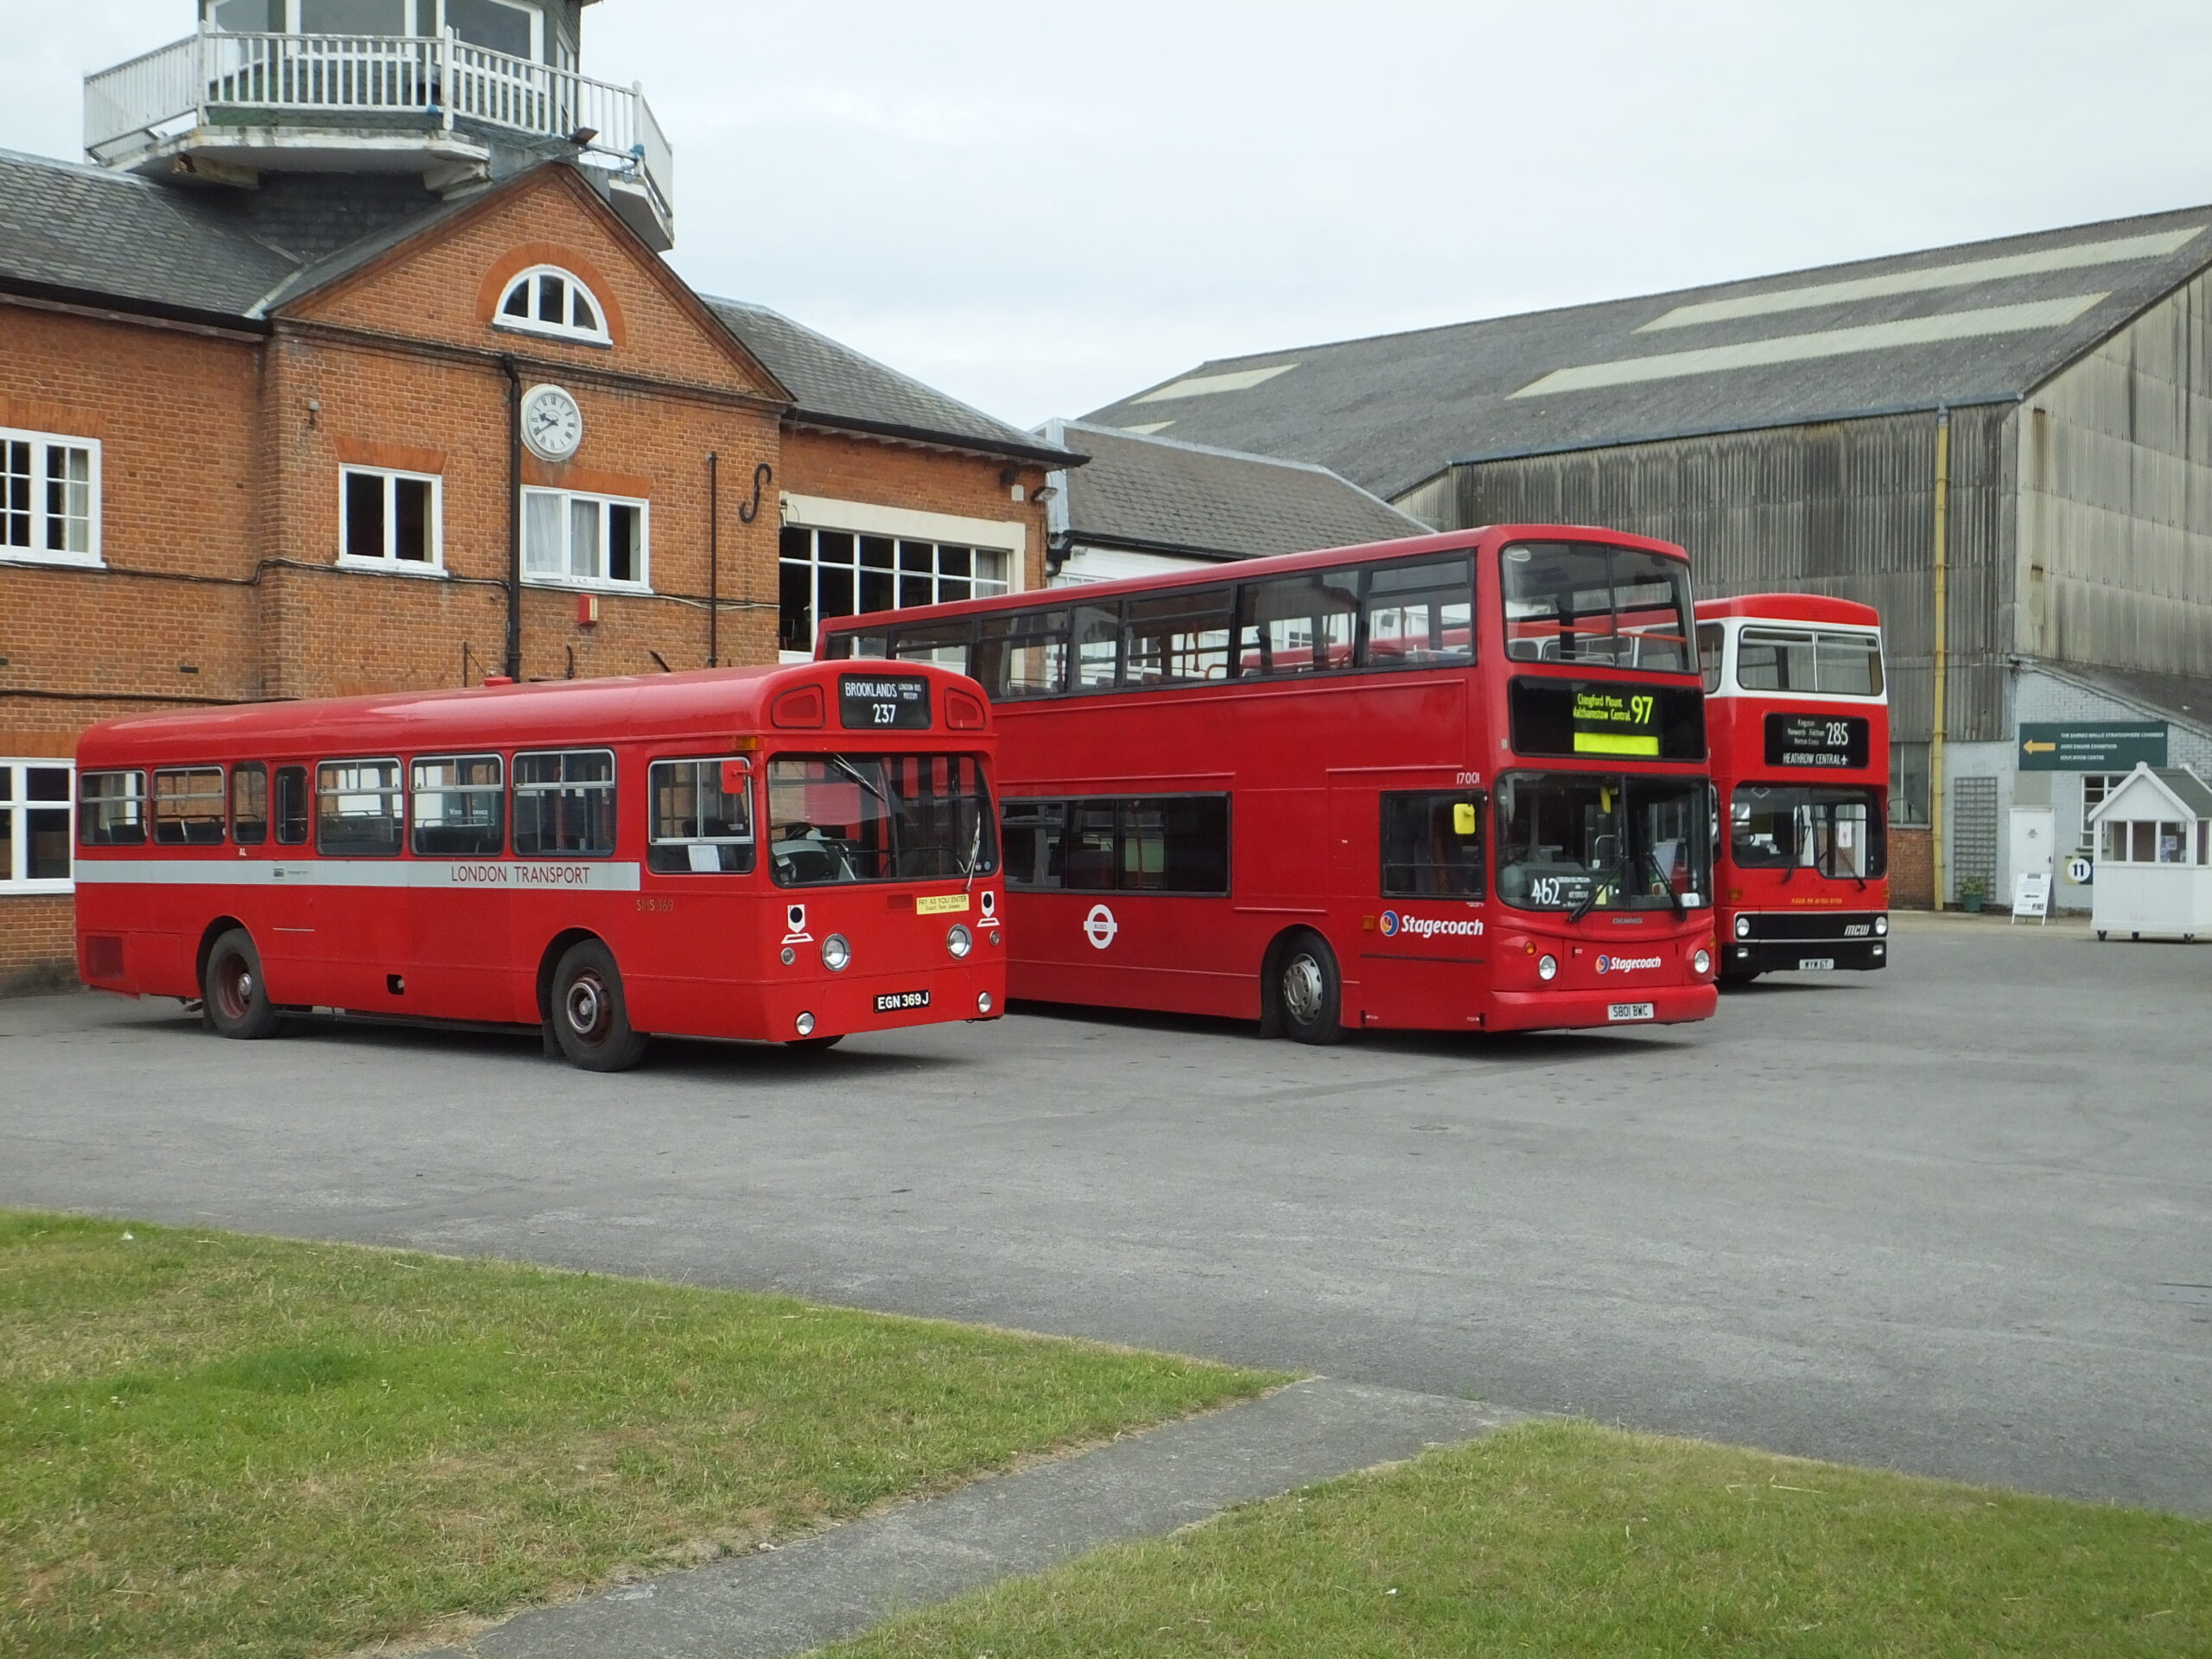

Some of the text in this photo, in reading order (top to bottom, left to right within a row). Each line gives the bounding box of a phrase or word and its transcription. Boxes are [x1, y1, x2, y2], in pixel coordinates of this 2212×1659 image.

[845, 682, 898, 697] BROOKLANDS
[1577, 693, 1623, 709] Chingford Mount
[873, 703, 896, 723] 237
[1611, 708, 1631, 721] Central
[1631, 696, 1654, 724] 97
[1826, 721, 1848, 746] 285
[1783, 753, 1840, 765] HEATHROW CENTRAL
[1457, 772, 1480, 785] 17001
[451, 866, 590, 884] LONDON TRANSPORT
[2072, 863, 2084, 876] 11
[1531, 877, 1560, 905] 462
[636, 899, 674, 912] SMS 369
[1401, 914, 1484, 938] Stagecoach
[1610, 956, 1662, 973] Stagecoach
[877, 991, 929, 1009] EGN 369J
[1612, 1004, 1649, 1018] S801 BWC
